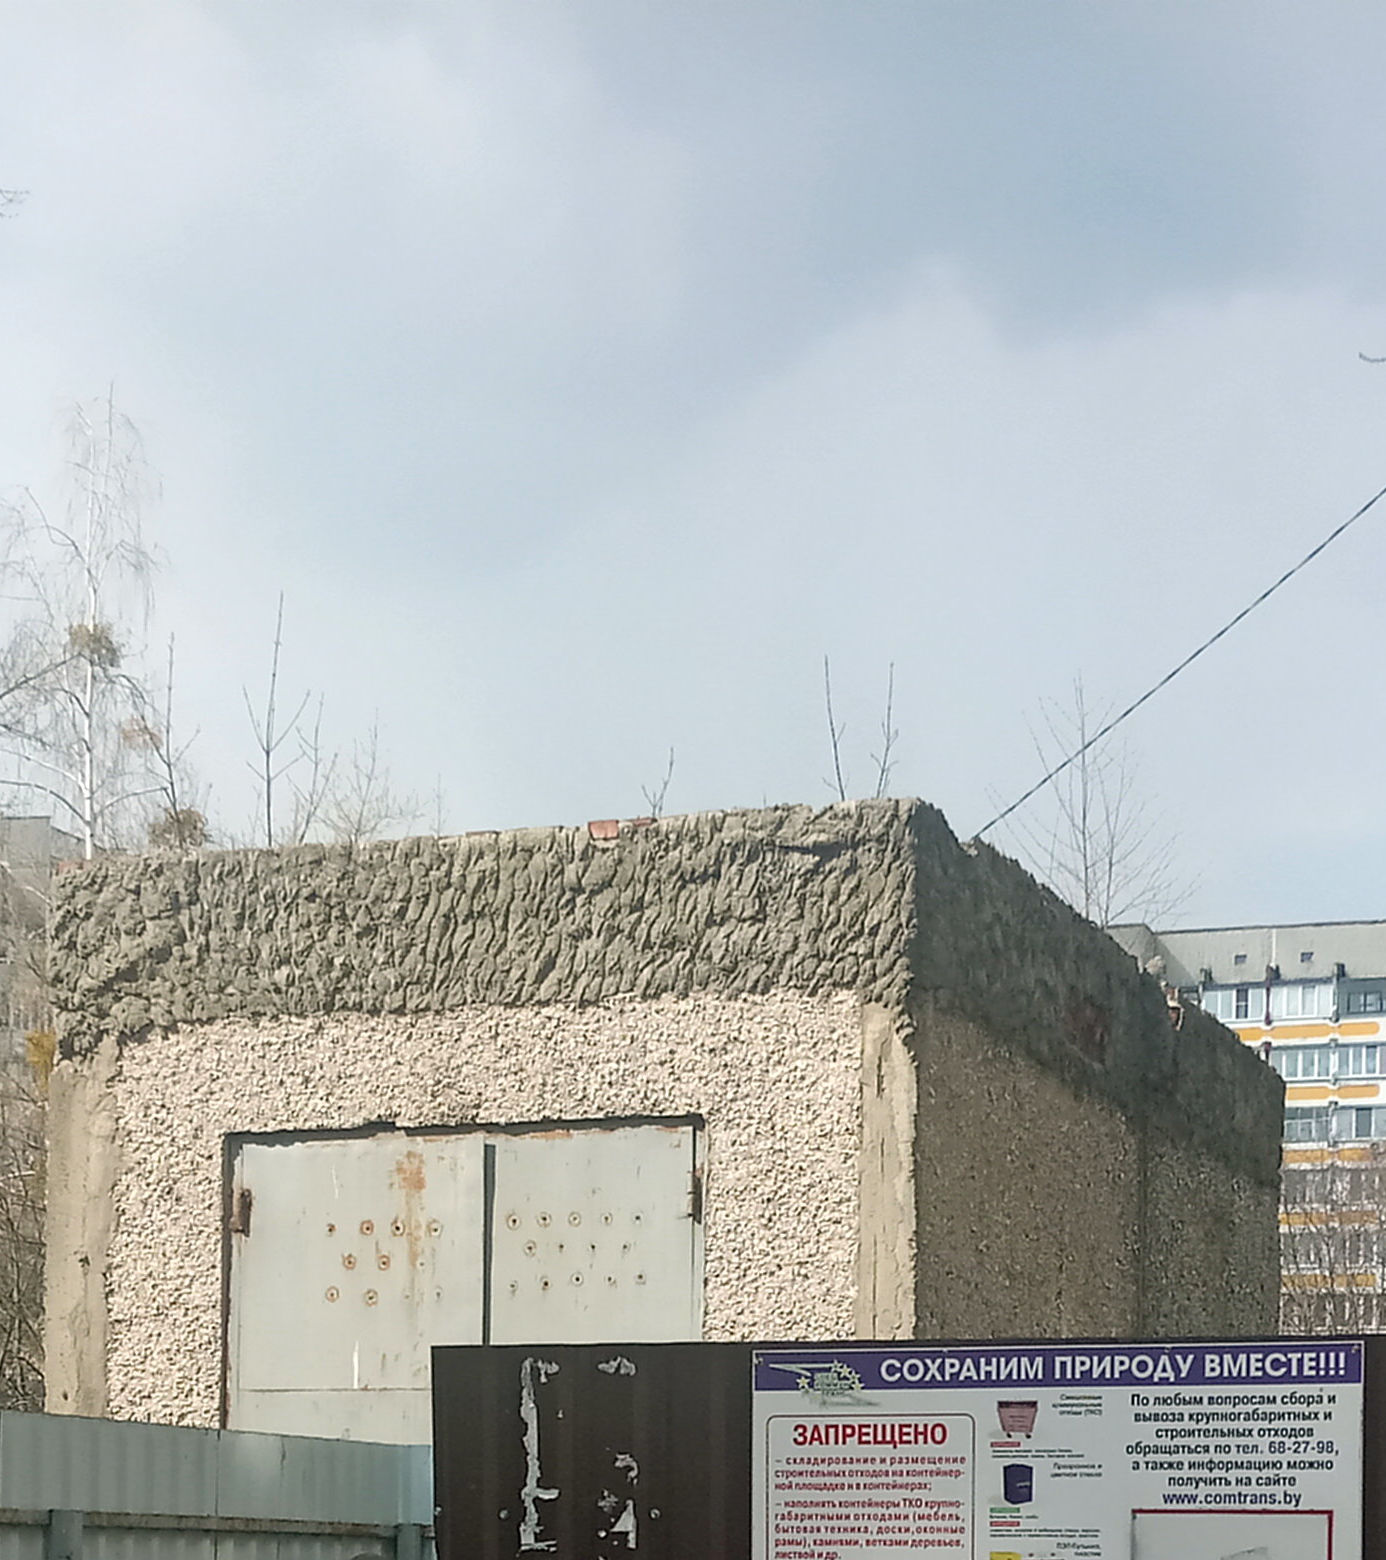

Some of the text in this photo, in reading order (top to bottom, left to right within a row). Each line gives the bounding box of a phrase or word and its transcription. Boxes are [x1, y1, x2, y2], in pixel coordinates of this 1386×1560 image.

[880, 1351, 1345, 1382] СОХРАНИМ ПРИРОДУ ВМЕСТЕ!!!
[1131, 1391, 1336, 1410] По любым вопросам сбора и
[1134, 1408, 1332, 1424] вывоза крупногабаритных и
[793, 1424, 947, 1449] ЗАПРЕЩЕНО
[1155, 1426, 1314, 1441] строительных отходов
[1126, 1441, 1339, 1457] обращаться по тел. 68-27-98,
[786, 1457, 877, 1467] складирование
[890, 1456, 966, 1466] размещение
[1131, 1458, 1333, 1475] а также информацию можно
[775, 1470, 846, 1479] строительных
[848, 1469, 889, 1478] отходов
[891, 1469, 903, 1477] на
[1168, 1473, 1297, 1489] получить на сайте
[784, 1500, 836, 1508] наполнять
[839, 1498, 900, 1510] контейнеры
[902, 1498, 923, 1508] ТКО
[1163, 1491, 1302, 1507] www.comtrans.by
[775, 1511, 850, 1523] габаритными
[853, 1513, 909, 1522] отходами
[775, 1523, 821, 1533] бытовая
